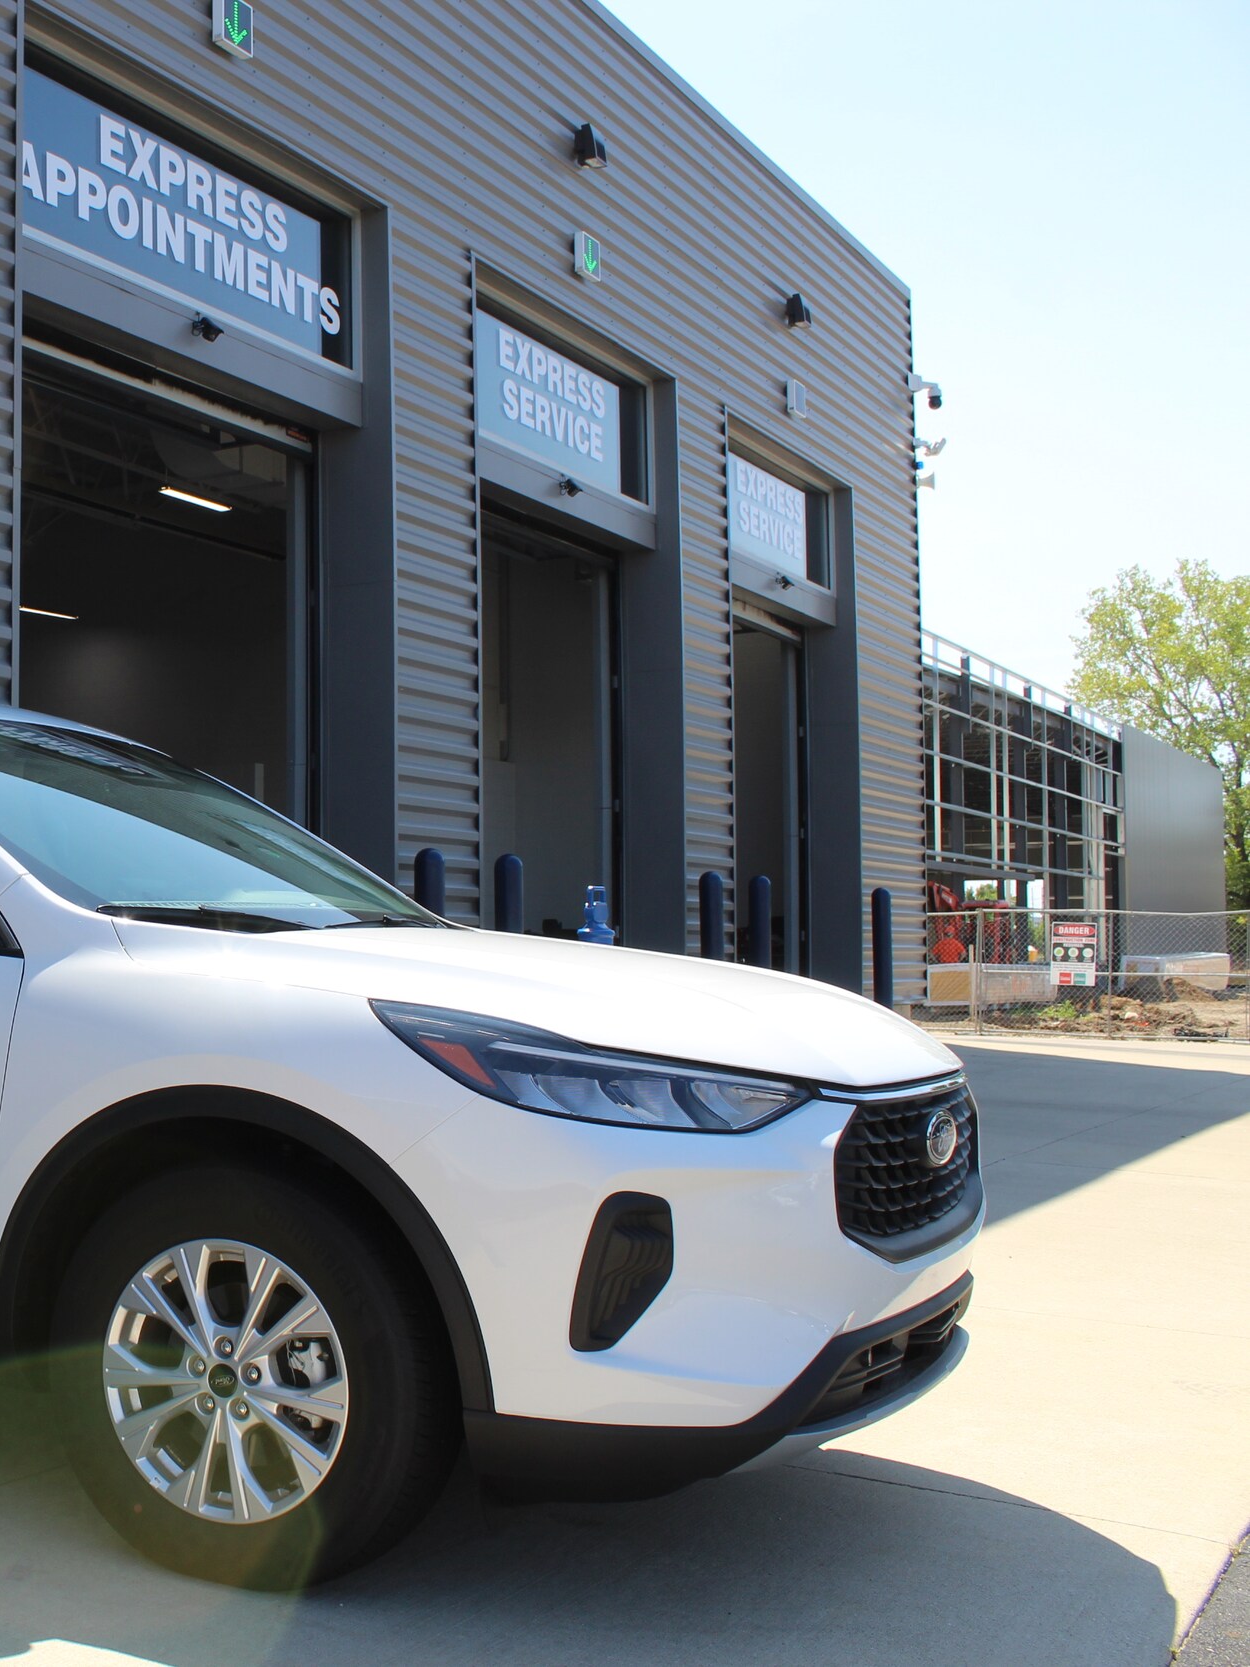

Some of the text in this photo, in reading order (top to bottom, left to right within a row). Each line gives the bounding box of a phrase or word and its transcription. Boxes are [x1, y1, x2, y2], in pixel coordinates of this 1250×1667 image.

[100, 113, 287, 252] EXPRESS
[22, 140, 341, 336] APPOINTMENTS
[499, 327, 606, 419] EXPRESS
[502, 378, 604, 463] SERVICE
[735, 460, 804, 526] EXPRESS
[738, 500, 804, 561] SERVICE
